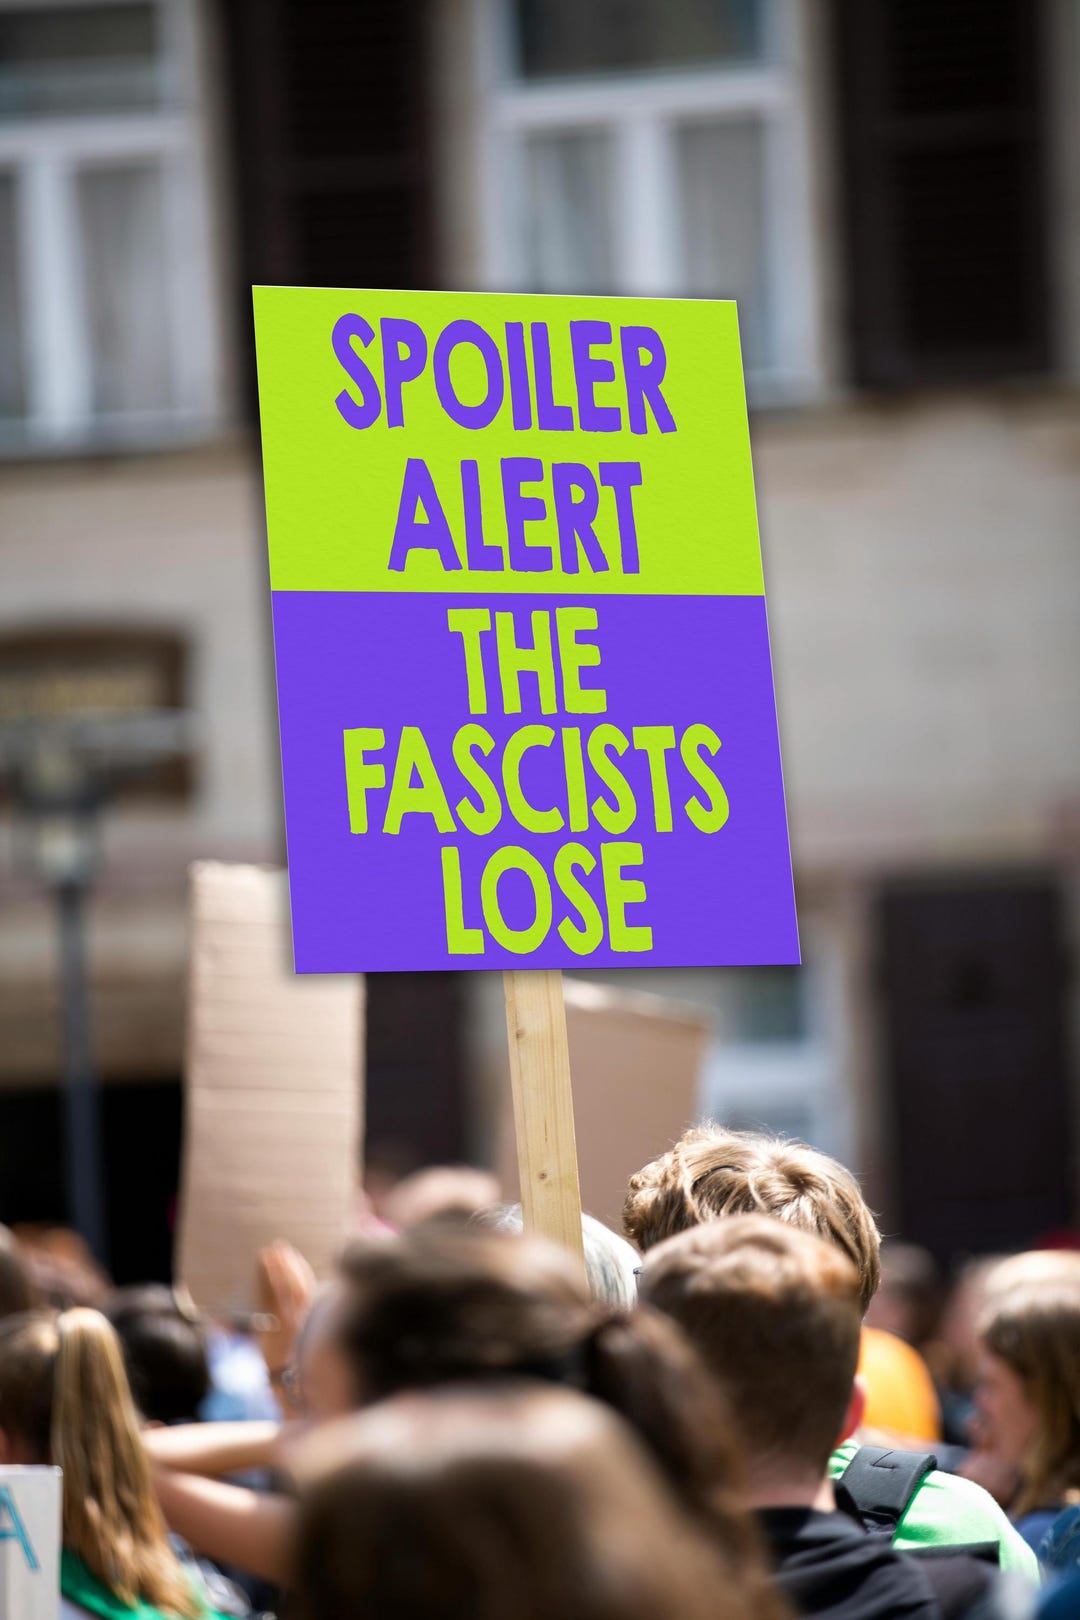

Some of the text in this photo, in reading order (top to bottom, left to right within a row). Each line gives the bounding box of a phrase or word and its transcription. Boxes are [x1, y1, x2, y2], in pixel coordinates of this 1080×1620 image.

[332, 314, 676, 434] SPOILER
[389, 458, 642, 574] ALERT
[448, 608, 606, 714] THE
[344, 724, 729, 834] FASCISTS
[442, 842, 653, 954] LOSE
